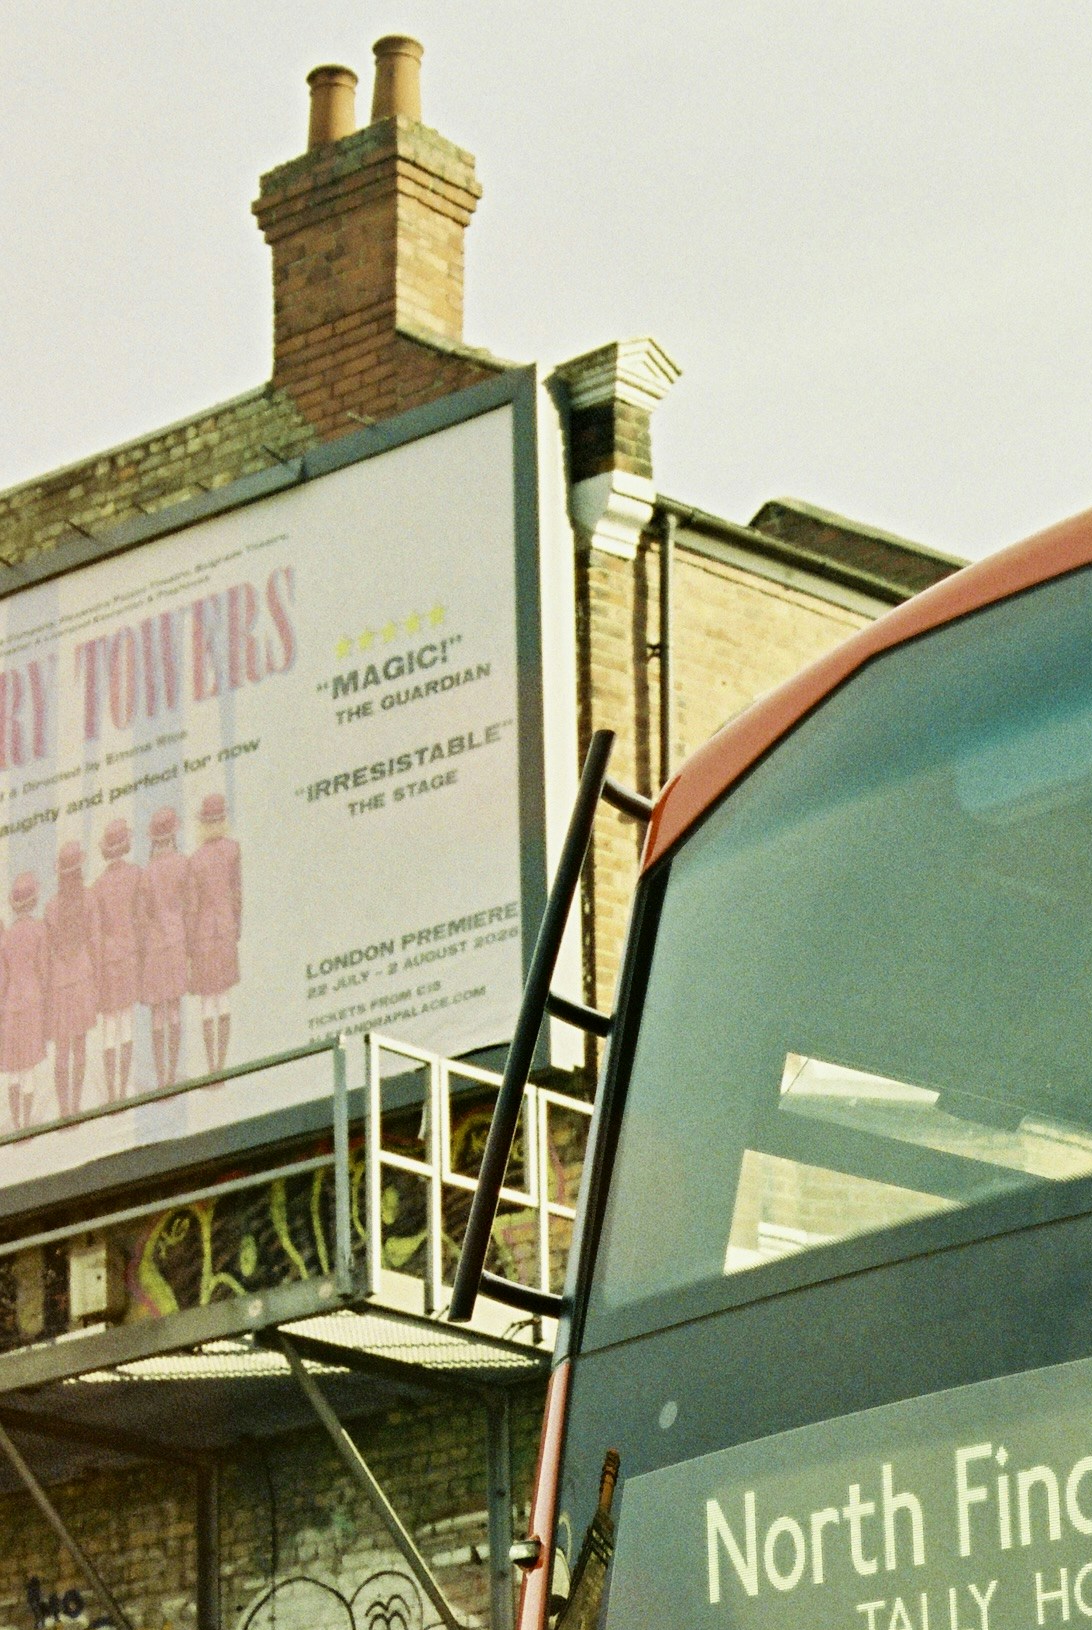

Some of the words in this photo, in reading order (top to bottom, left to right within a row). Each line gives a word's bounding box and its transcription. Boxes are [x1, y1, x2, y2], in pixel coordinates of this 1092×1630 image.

[74, 566, 296, 742] TOWERS
[335, 701, 374, 725] THE
[380, 662, 492, 711] GUARDIAN
[66, 789, 103, 814] and
[109, 764, 178, 803] perfect
[184, 755, 212, 773] for
[217, 738, 261, 762] now
[347, 792, 386, 817] THE
[392, 768, 458, 802] STAGE
[306, 940, 395, 980] LONDON
[401, 900, 518, 951] PREMIERE
[307, 982, 328, 1000] 22
[332, 969, 370, 992] JULY
[387, 962, 398, 976] 2
[403, 939, 468, 970] AUGUST
[307, 1001, 367, 1029] TICKETS
[370, 988, 412, 1010] FROM
[704, 1462, 928, 1605] North
